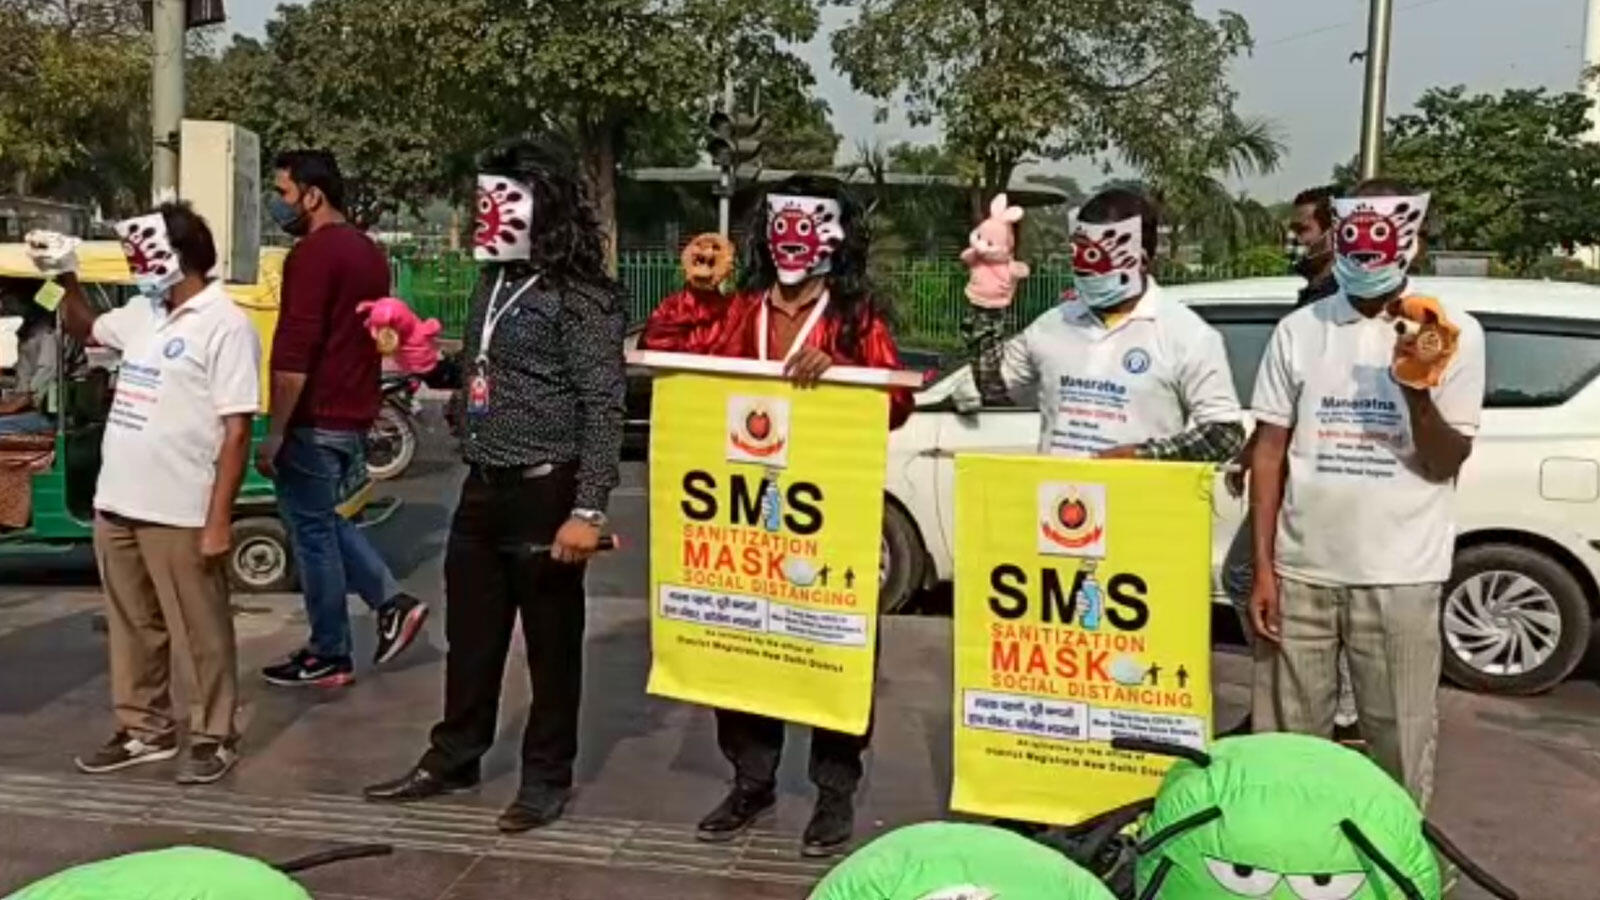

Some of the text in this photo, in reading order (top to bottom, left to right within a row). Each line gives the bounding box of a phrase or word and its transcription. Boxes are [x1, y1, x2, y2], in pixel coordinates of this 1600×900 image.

[681, 469, 824, 535] SMS
[683, 524, 818, 556] SANITIZATION
[684, 540, 788, 582] MASK
[683, 570, 857, 606] SOCIAL DISTANCING
[989, 563, 1150, 632] SMS
[991, 622, 1145, 653] SANITIZATION
[783, 653, 807, 665] Delhi
[992, 640, 1113, 683] MASK
[991, 673, 1193, 708] SOCIAL DISTANCING
[1084, 760, 1105, 769] New
[1110, 763, 1137, 773] Delhi
